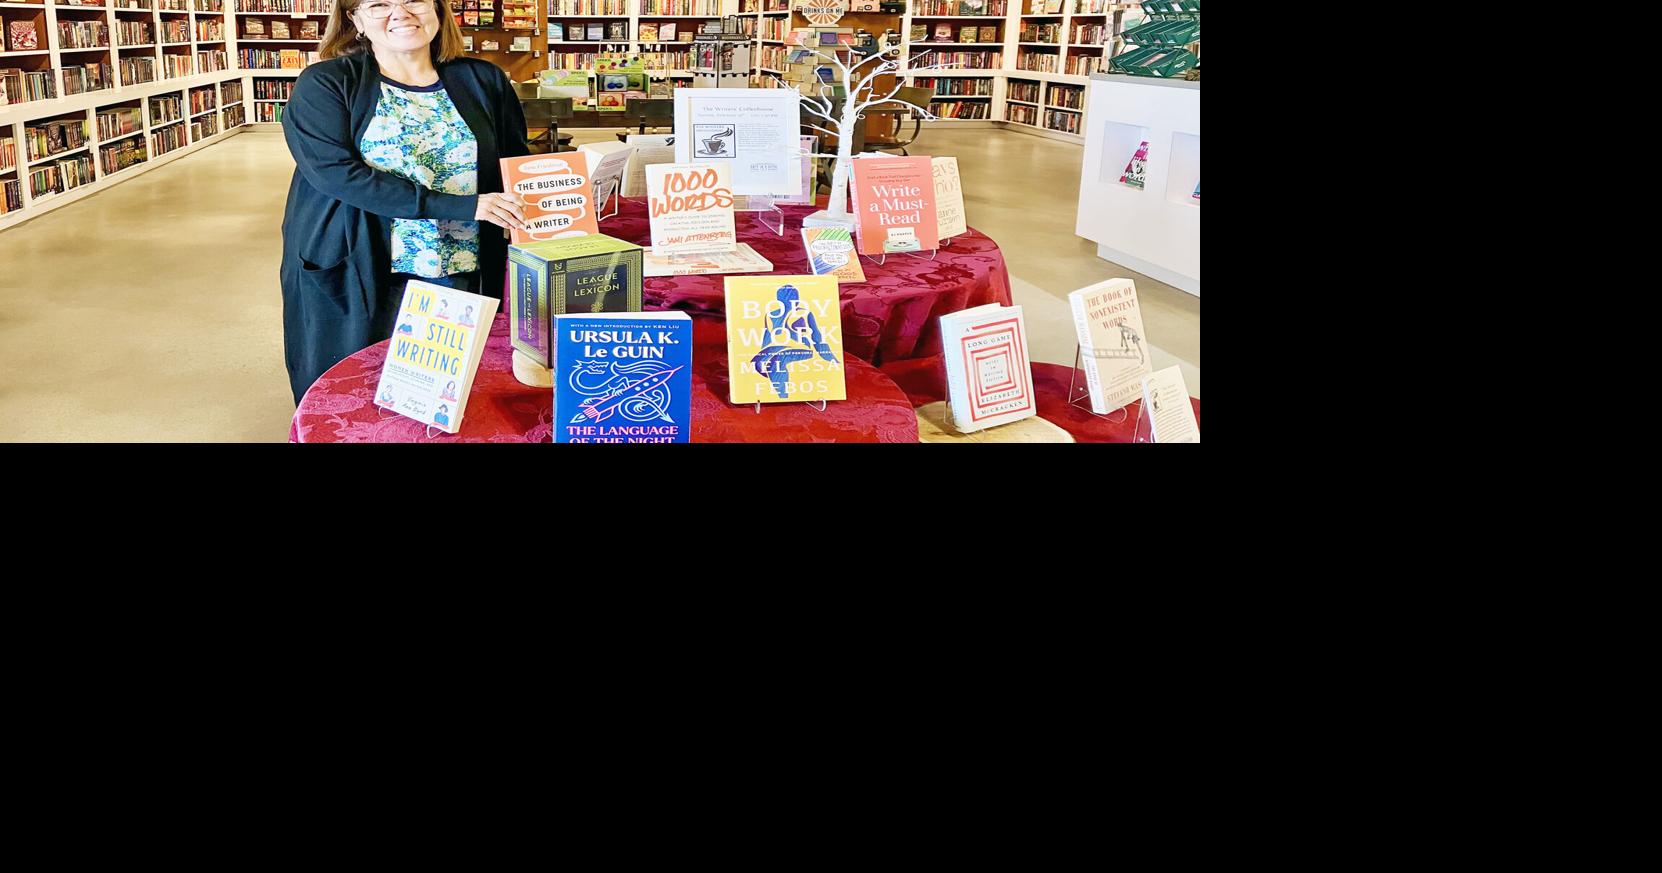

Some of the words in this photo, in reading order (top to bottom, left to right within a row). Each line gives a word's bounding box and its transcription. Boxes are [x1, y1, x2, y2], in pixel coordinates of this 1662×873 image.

[517, 183, 535, 191] THE
[537, 178, 582, 189] BUSINESS
[663, 168, 719, 195] 1000
[871, 184, 921, 198] Write
[541, 201, 553, 209] OF
[556, 197, 583, 207] BEING
[652, 188, 735, 218] WORDS
[870, 202, 879, 212] a
[882, 198, 929, 211] Must-
[534, 218, 570, 229] WRITER
[879, 210, 921, 226] Read
[577, 272, 619, 286] LEAGUE
[574, 283, 620, 298] LEXICON
[1087, 296, 1101, 308] THE
[1102, 290, 1122, 304] BOOK
[1123, 287, 1133, 298] OF
[408, 292, 431, 313] I'M
[742, 299, 832, 320] BODY
[1089, 299, 1136, 321] NONEXISTENT
[1102, 315, 1128, 330] WORDS
[427, 322, 465, 351] STILL
[570, 330, 654, 344] URSULA
[658, 331, 680, 345] K.
[737, 324, 841, 348] WORK
[967, 339, 990, 349] LONG
[991, 334, 1011, 345] GAME
[397, 338, 460, 376] WRITING
[584, 345, 608, 358] Le
[612, 345, 665, 359] GUIN
[740, 358, 842, 375] MELISSA
[754, 380, 830, 397] FEBOS
[981, 389, 1020, 404] ELIZABETH
[566, 425, 597, 436] THE
[600, 425, 679, 436] LANGUAGE
